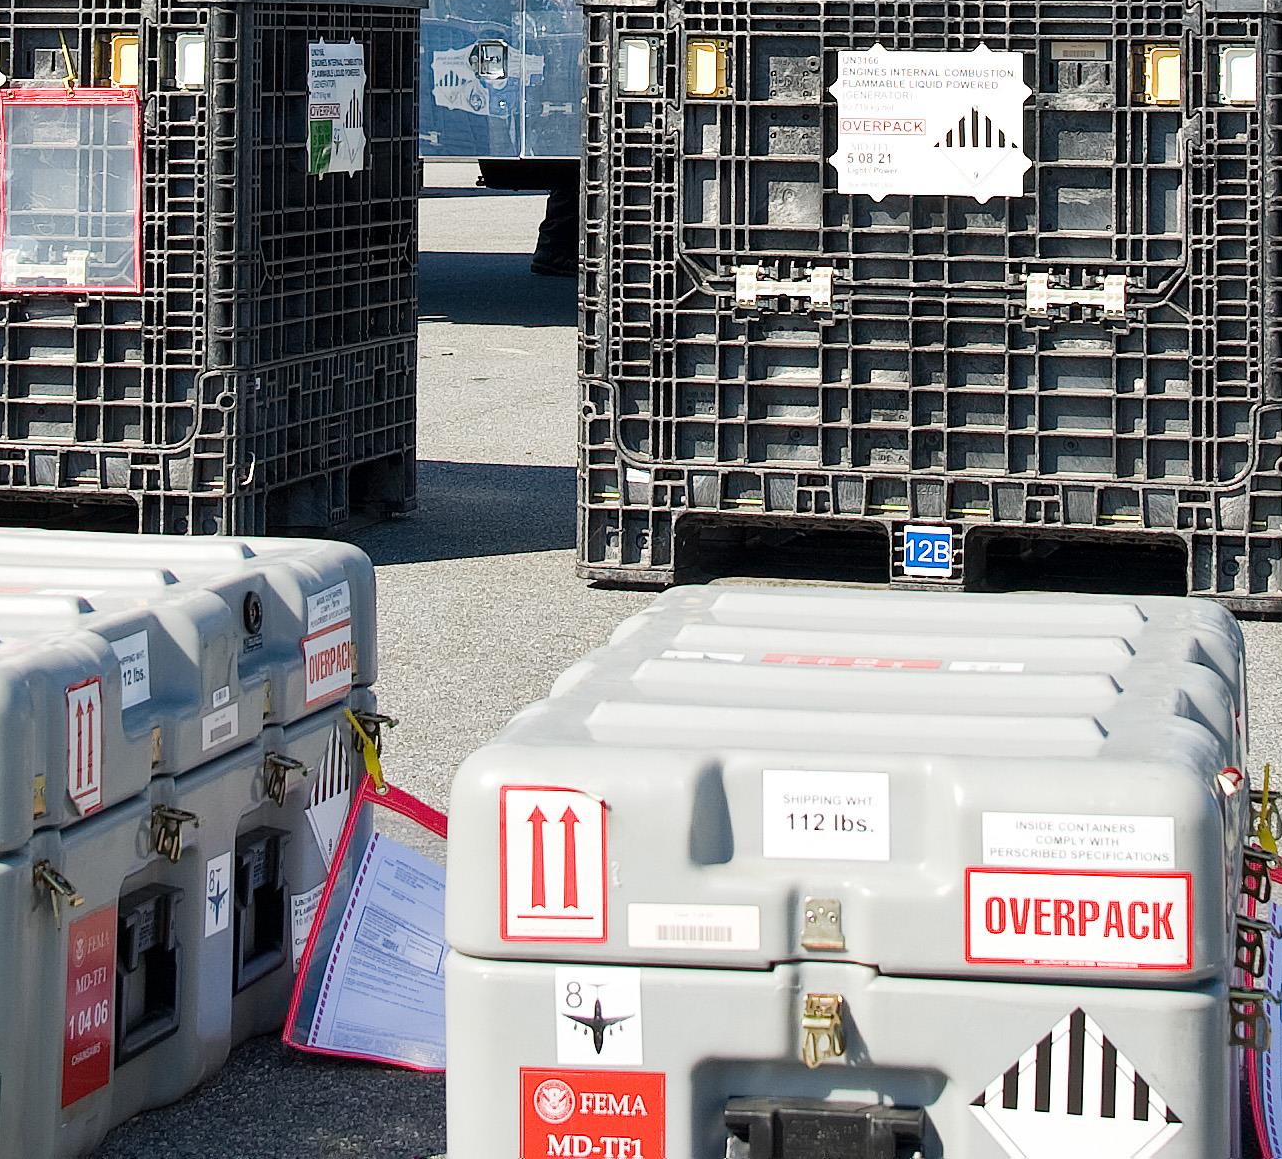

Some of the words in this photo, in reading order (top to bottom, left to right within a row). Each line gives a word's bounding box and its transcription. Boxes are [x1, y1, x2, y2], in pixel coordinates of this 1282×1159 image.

[842, 68, 887, 76] ENGINES
[889, 68, 940, 77] INTERNAL
[842, 79, 906, 88] FLAMMABLE
[908, 80, 943, 89] LIQUID
[945, 81, 999, 89] POWERED
[841, 120, 924, 133] OVERPACK
[847, 153, 854, 163] 5
[857, 153, 873, 164] 08
[877, 154, 892, 163] 21
[872, 167, 899, 175] Power
[905, 539, 950, 563] 12B
[783, 793, 842, 806] SHIPPING
[786, 812, 825, 831] 112
[834, 813, 875, 833] lbs.
[1015, 820, 1054, 832] INSIDE
[1057, 821, 1136, 834] CONTAINERS
[1035, 835, 1086, 847] COMPLY
[1089, 836, 1119, 847] WITH
[989, 847, 1068, 860] PERSCRIBED
[1070, 850, 1170, 864] SPECIFICATIONS
[208, 869, 216, 892] 8
[984, 895, 1176, 941] OVERPACK
[87, 931, 110, 954] FEMA
[75, 966, 108, 996] MD-TF1
[565, 981, 582, 1008] 8
[69, 1017, 75, 1040] 1
[78, 1009, 92, 1037] 04
[94, 999, 109, 1026] 06
[579, 1092, 649, 1117] FEMA
[547, 1134, 643, 1158] MD-TF1
